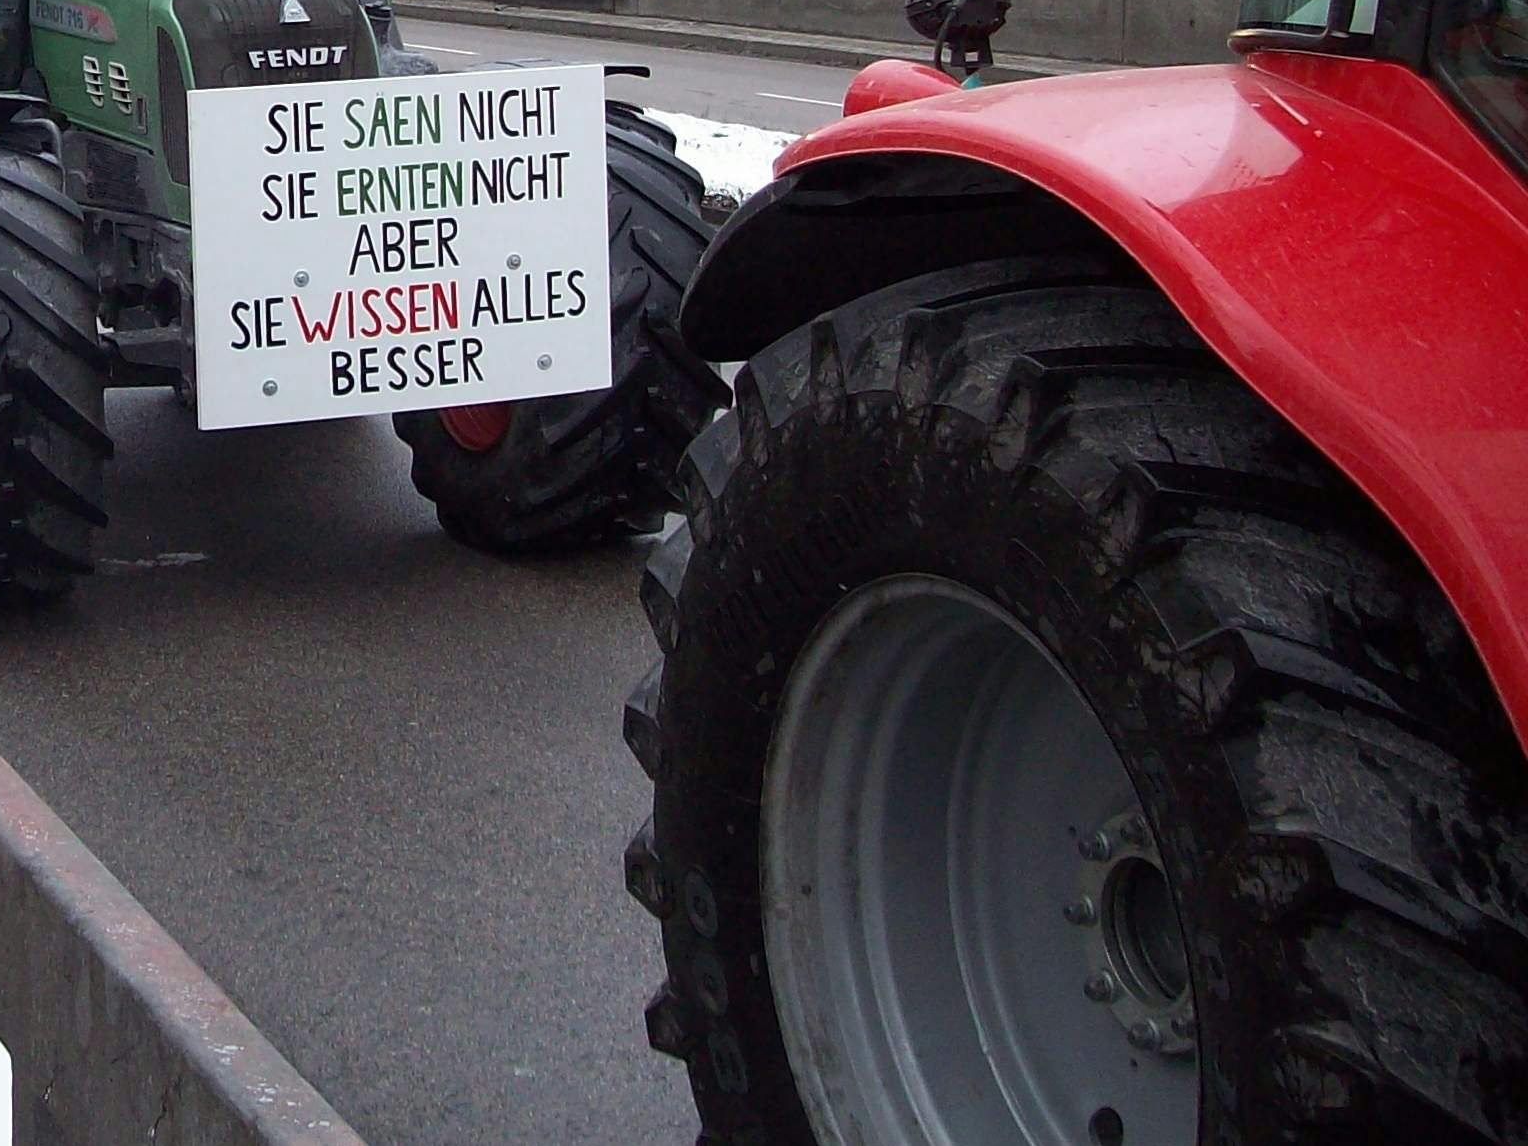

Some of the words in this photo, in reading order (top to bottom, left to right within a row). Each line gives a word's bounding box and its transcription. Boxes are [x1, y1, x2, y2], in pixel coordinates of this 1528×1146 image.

[248, 45, 348, 69] FENDT
[263, 101, 325, 155] SIE
[343, 91, 441, 149] SÄEN
[457, 85, 561, 143] NICHT
[261, 171, 319, 222] SIE
[336, 160, 463, 216] ERNTEN
[471, 151, 570, 206] NICHT
[348, 216, 460, 276] ABER
[230, 296, 287, 350] SIE
[291, 280, 458, 344] WISSEN
[471, 269, 586, 328] ALLES
[331, 337, 484, 396] BESSER
